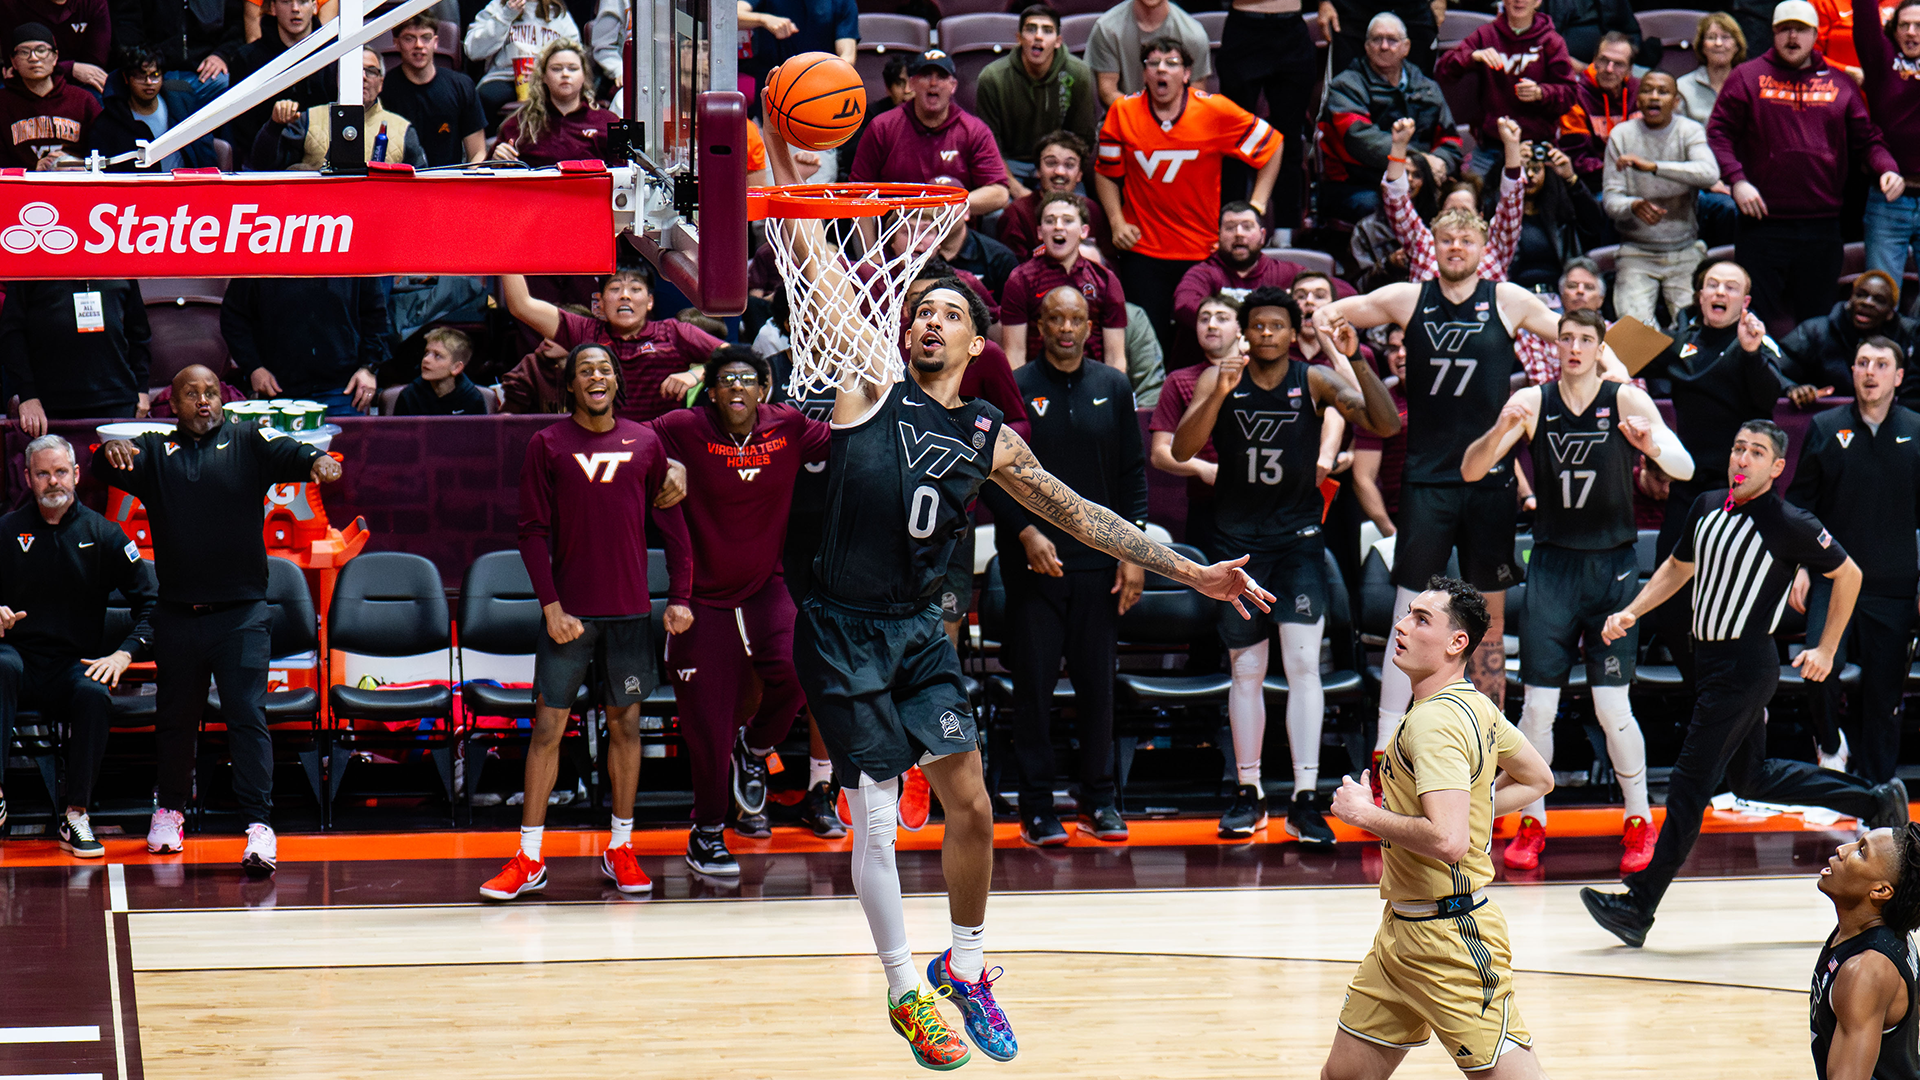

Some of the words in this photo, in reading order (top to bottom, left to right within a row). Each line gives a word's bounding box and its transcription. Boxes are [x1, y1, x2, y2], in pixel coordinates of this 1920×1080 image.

[11, 116, 54, 146] VIRGINIA
[53, 116, 81, 143] TECH
[1133, 149, 1200, 184] VT
[1423, 321, 1485, 352] VT
[1429, 357, 1478, 397] 77
[1234, 409, 1300, 442] VT
[707, 442, 760, 456] VIRGINIA
[759, 436, 788, 454] TECH
[726, 453, 771, 468] HOKIES
[898, 420, 978, 479] VT
[1547, 431, 1610, 465] VT
[572, 451, 634, 483] VT
[737, 467, 761, 482] VT
[1245, 446, 1284, 486] 13
[1559, 469, 1597, 509] 17
[908, 485, 940, 539] 0
[676, 667, 698, 682] VT
